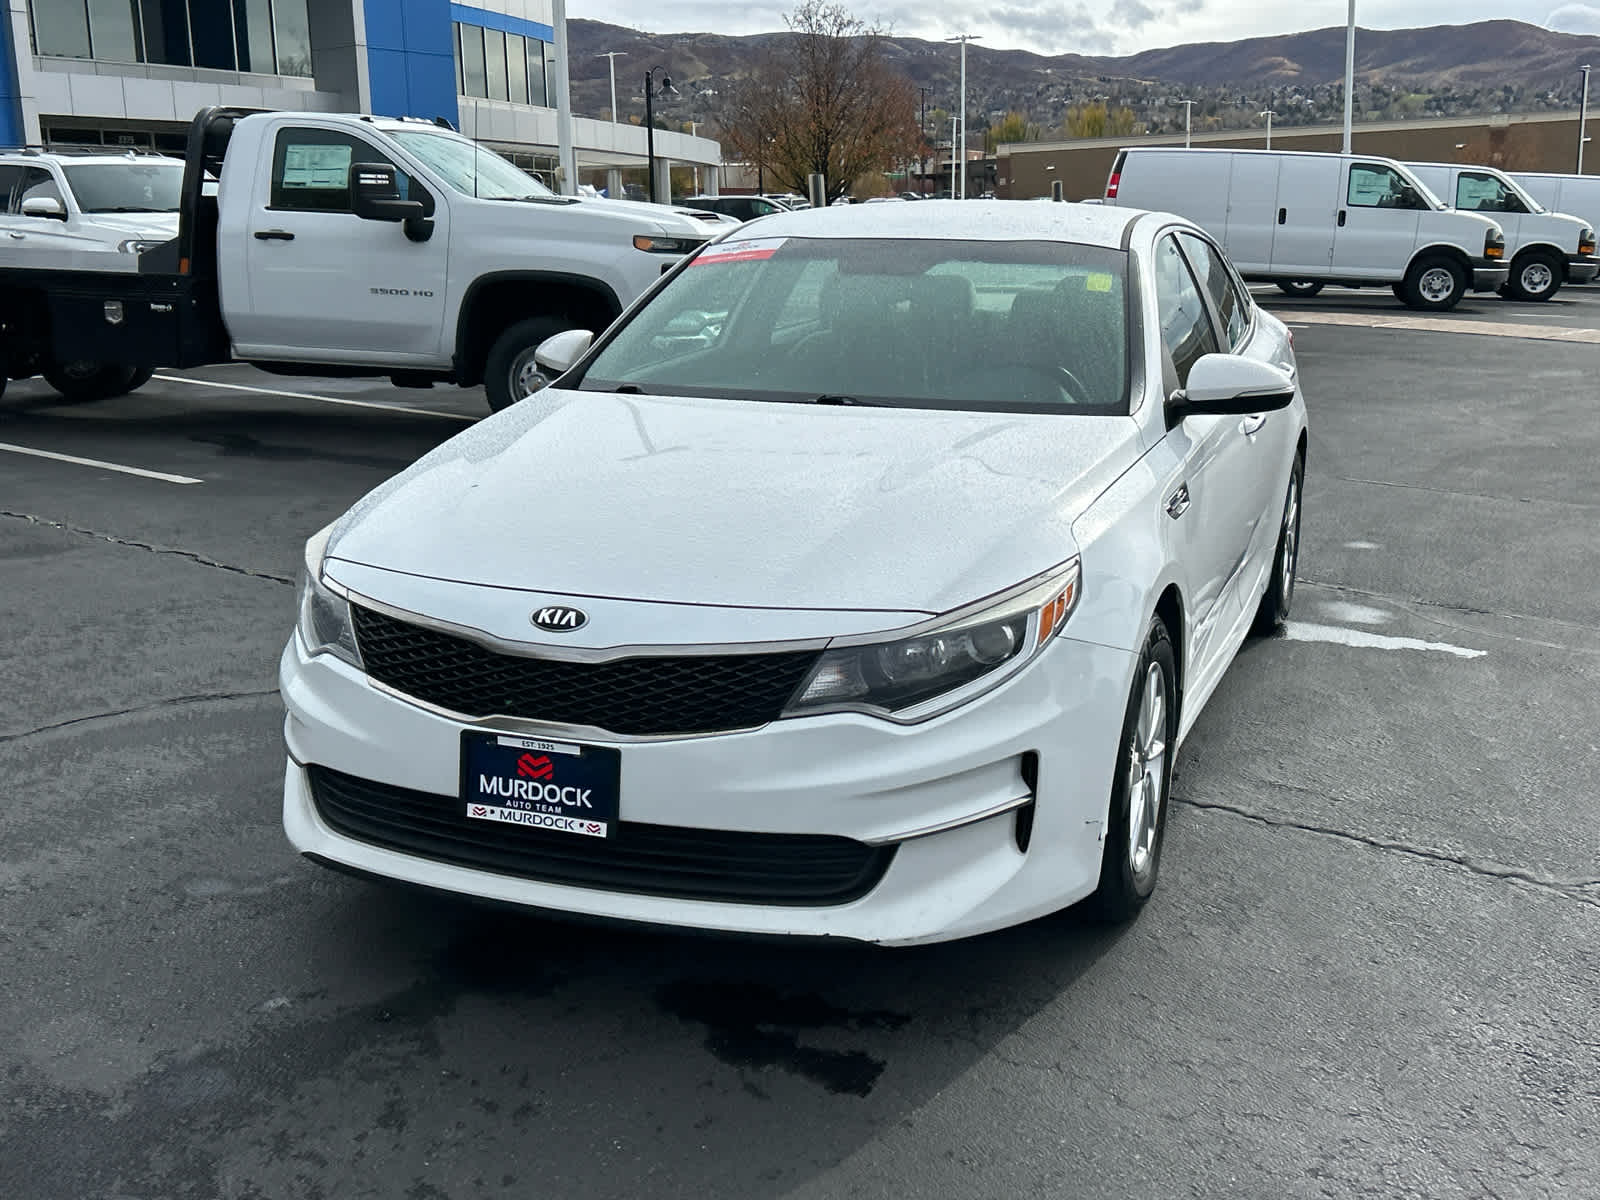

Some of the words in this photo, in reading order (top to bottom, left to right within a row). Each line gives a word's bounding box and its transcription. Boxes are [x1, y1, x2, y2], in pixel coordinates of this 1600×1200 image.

[413, 289, 433, 298] HD
[537, 608, 577, 627] KIA
[537, 742, 555, 751] 1925
[480, 774, 592, 808] MURDOCK
[505, 800, 532, 810] AUTO
[535, 804, 562, 815] TEAM
[500, 810, 575, 831] MURDOCK
